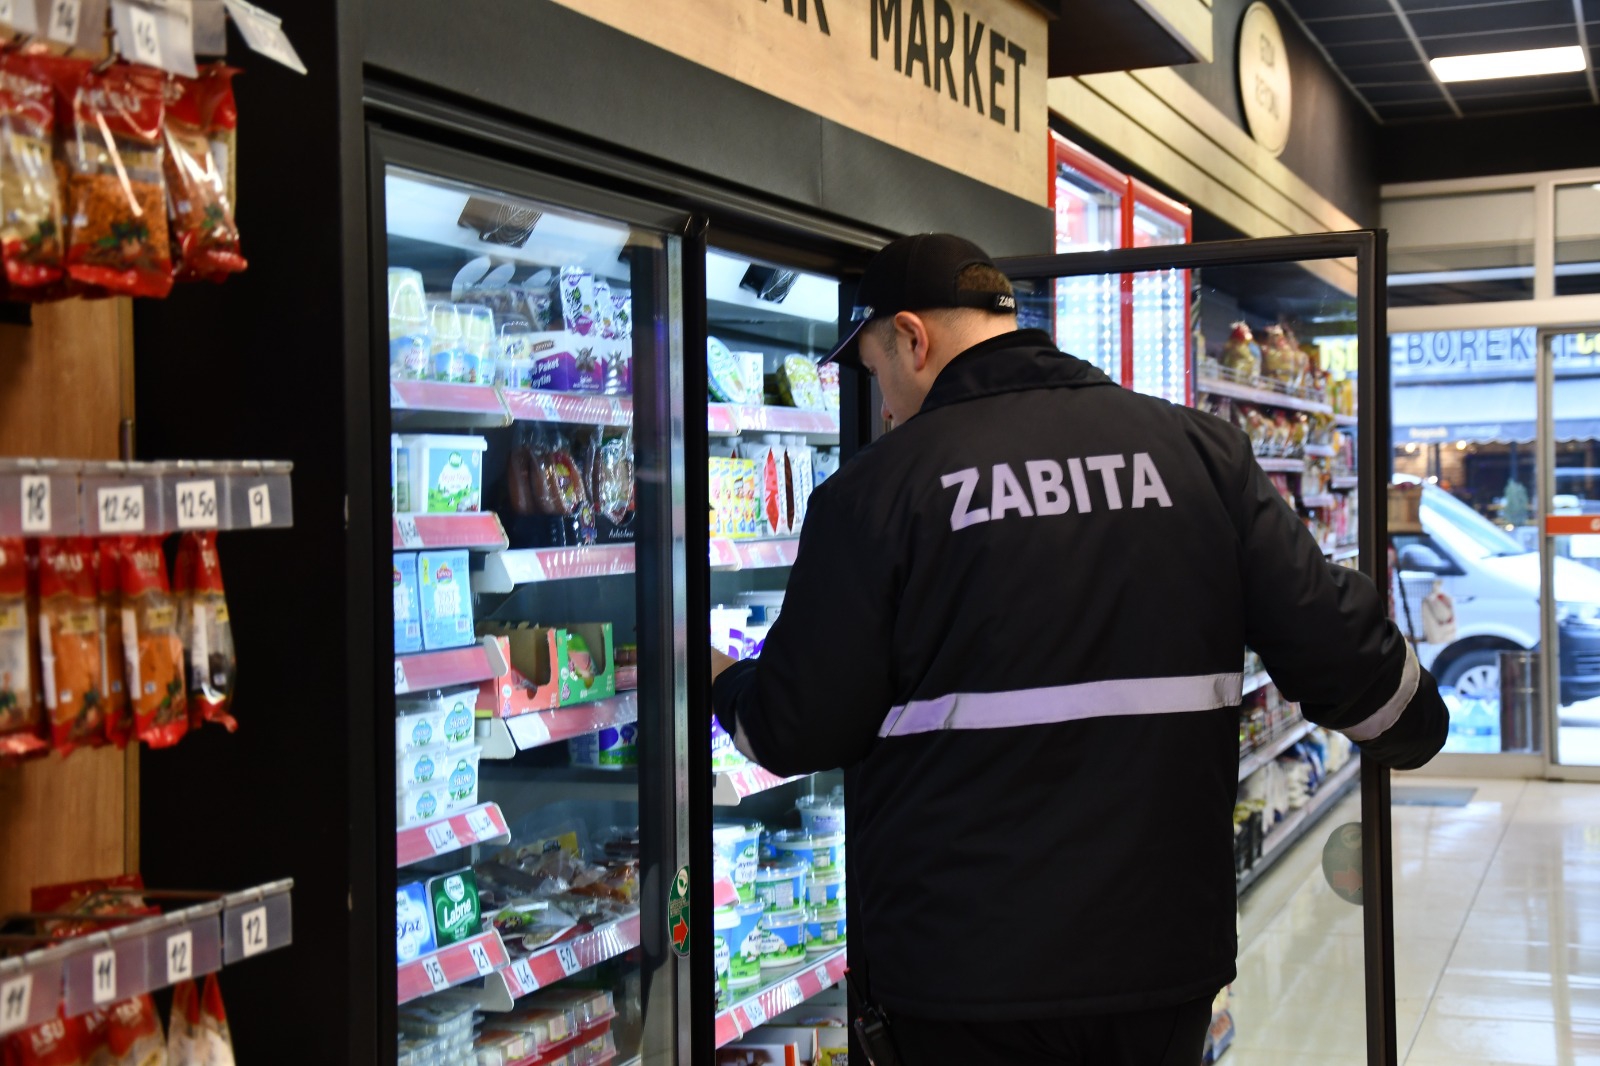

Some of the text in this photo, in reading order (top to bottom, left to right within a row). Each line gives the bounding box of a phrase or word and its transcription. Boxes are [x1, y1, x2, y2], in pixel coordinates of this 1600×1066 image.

[870, 0, 1027, 133] MARKET
[253, 491, 264, 514] 9
[939, 452, 1174, 532] ZABITA
[443, 897, 472, 929] Labne
[245, 916, 263, 945] 12
[97, 957, 112, 990] 11
[170, 941, 188, 974] 12
[426, 961, 445, 986] 25
[6, 984, 26, 1019] 11
